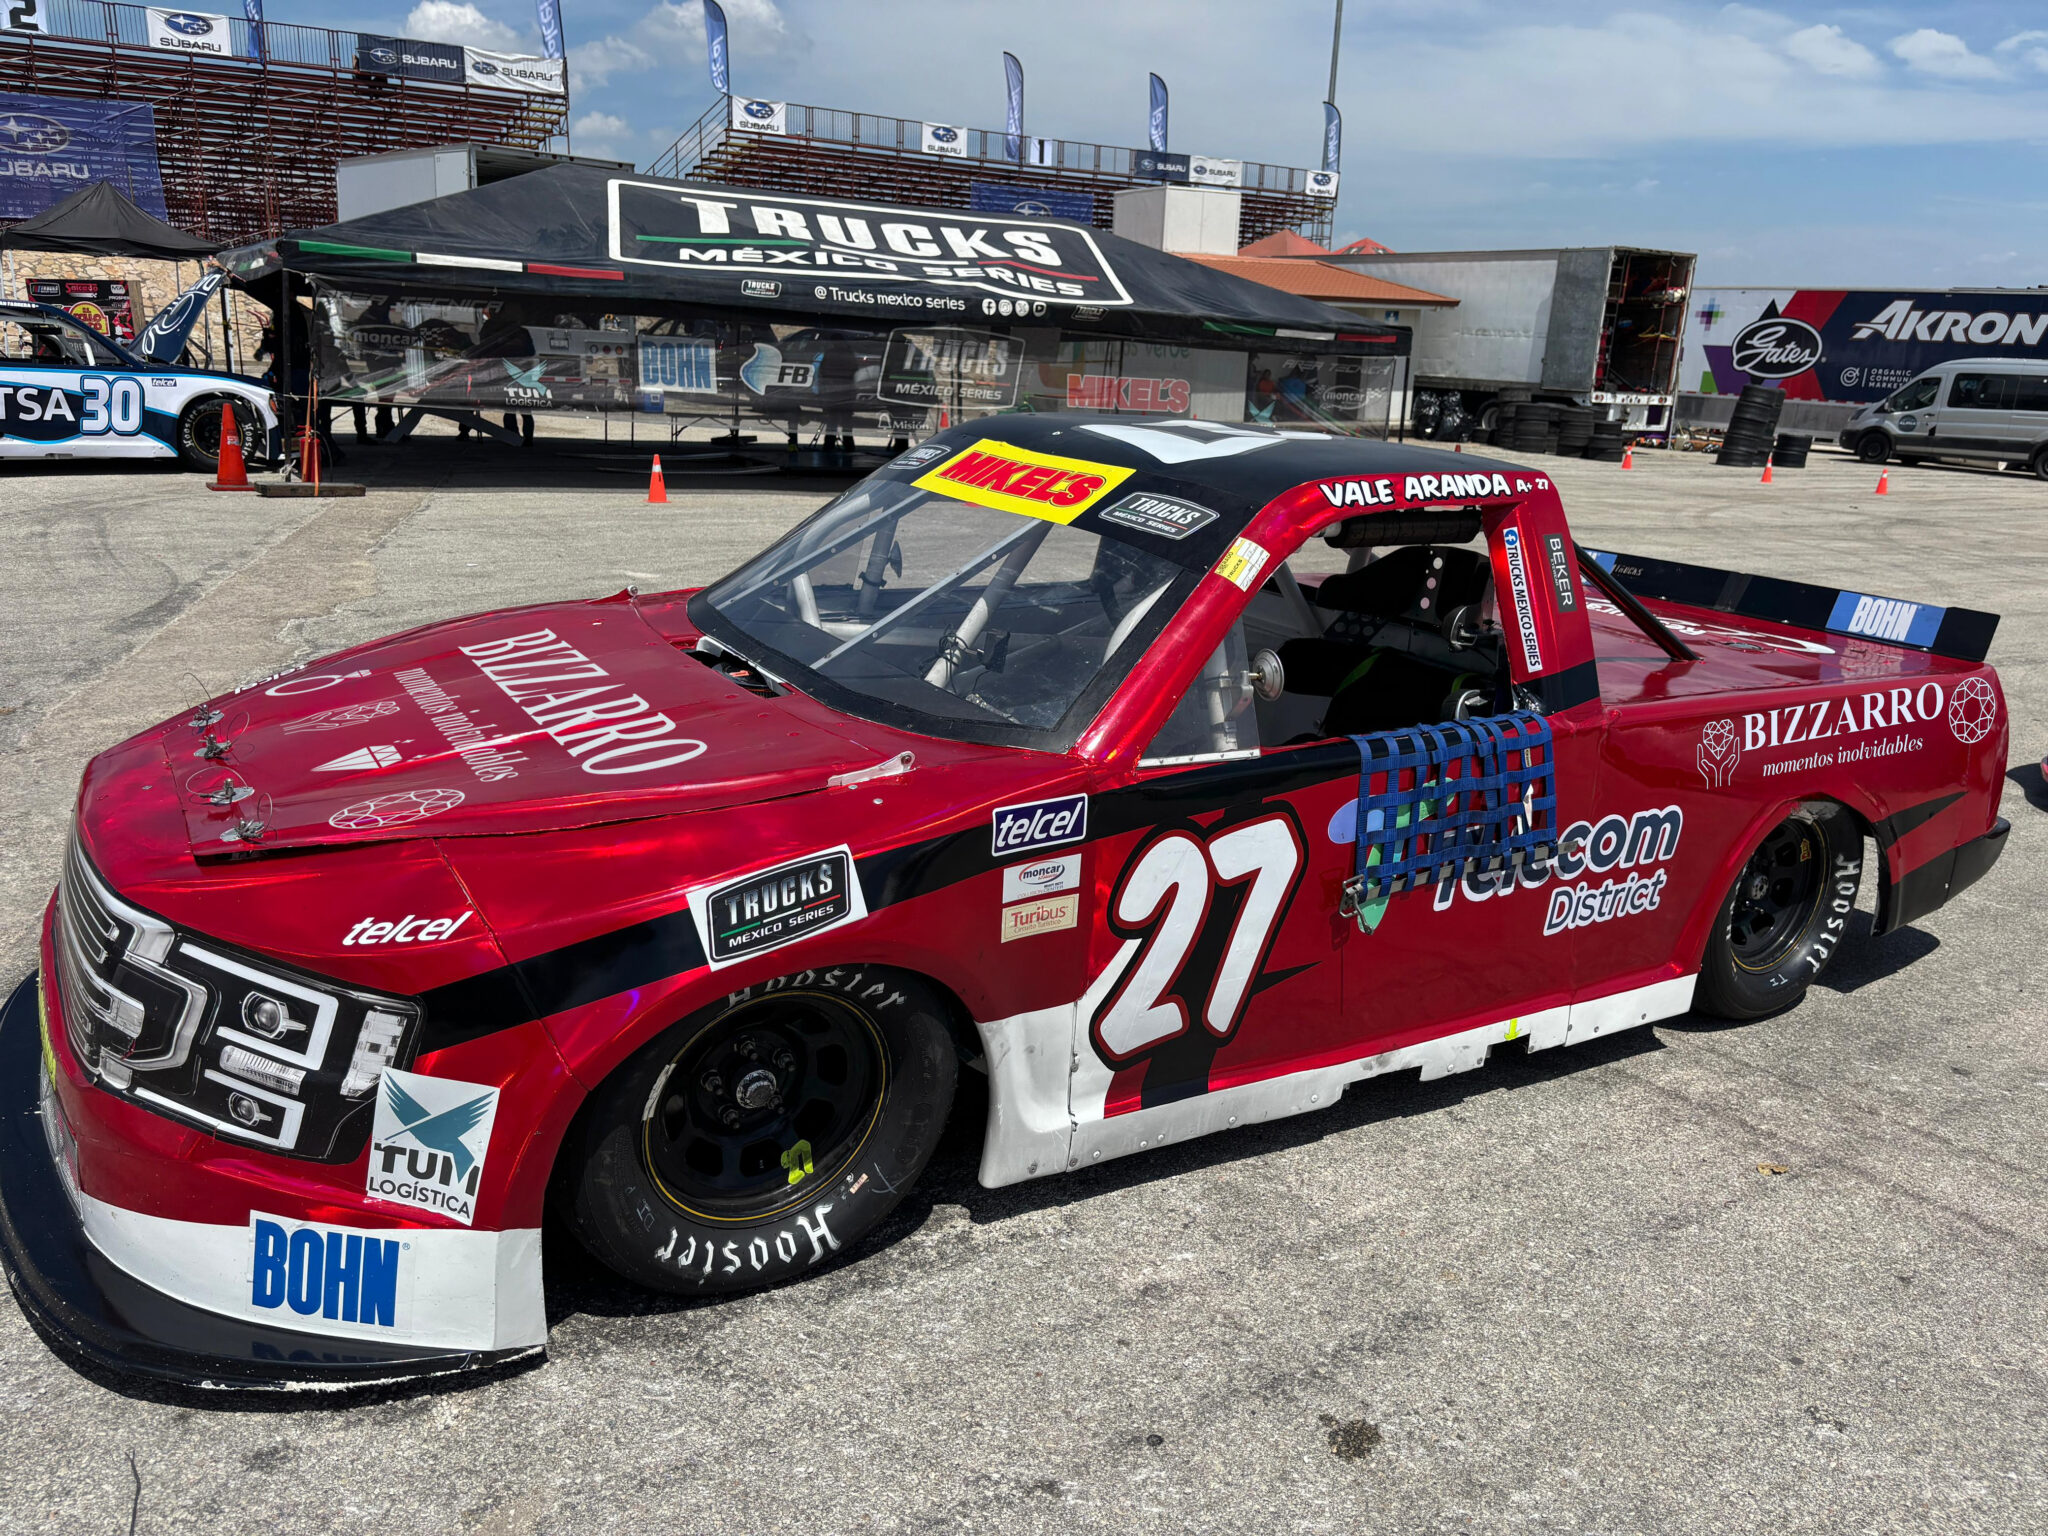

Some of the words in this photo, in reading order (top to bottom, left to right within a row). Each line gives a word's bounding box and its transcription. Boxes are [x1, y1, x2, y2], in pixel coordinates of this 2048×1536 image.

[159, 37, 222, 53] SUBARU
[401, 54, 458, 69] SUBARU
[501, 67, 553, 82] SUBARU
[739, 120, 780, 132] SUBARU
[927, 144, 962, 155] SUBARU
[1156, 162, 1187, 173] SUBARU
[1208, 168, 1237, 178] SUBARU
[1309, 187, 1333, 196] SUBARU
[680, 196, 1062, 267] TRUCKS
[679, 247, 899, 272] MÉXICO
[922, 266, 1085, 297] SERIES
[829, 286, 875, 304] Trucks
[877, 293, 924, 309] mexico
[926, 296, 966, 312] series
[352, 330, 419, 346] moncar
[1850, 299, 2048, 346] AKRON
[640, 340, 712, 390] BOHN
[902, 339, 1010, 377] TRUCKS
[1740, 325, 1814, 369] Gates
[777, 364, 812, 385] FB
[1870, 368, 1912, 377] ORGANIC
[80, 375, 145, 436] 30
[958, 387, 1003, 401] SERIES
[1066, 373, 1191, 413] MIKEL'S
[936, 450, 1107, 508] MIKEL'S
[1319, 478, 1395, 508] VALE
[1403, 473, 1512, 501] ARANDA
[1534, 477, 1549, 491] 27
[1128, 497, 1202, 525] TRUCKS
[1145, 519, 1178, 534] SERIES
[1507, 545, 1524, 587] TRUCKS
[1549, 537, 1574, 606] BEKER
[1515, 588, 1533, 630] MEXICO
[1848, 596, 1920, 642] BOHN
[1523, 631, 1541, 667] SERIES
[457, 628, 708, 775] BIZZARRO
[1742, 681, 1944, 752] BIZZARRO
[392, 667, 461, 715] momentos
[430, 708, 530, 783] inolvidables
[1762, 751, 1834, 778] momentos
[1837, 733, 1923, 763] inolvidables
[996, 801, 1083, 848] telcel
[1022, 864, 1061, 880] moncar
[724, 863, 834, 926] TRUCKS
[1543, 868, 1668, 937] District
[341, 911, 475, 946] telcel
[788, 904, 835, 928] SERIES
[1011, 905, 1067, 928] Turibus
[1098, 816, 1300, 1057] 27
[374, 1141, 482, 1197] TUM
[368, 1176, 472, 1220] LOGÍSTICA
[251, 1219, 401, 1328] BOHN
